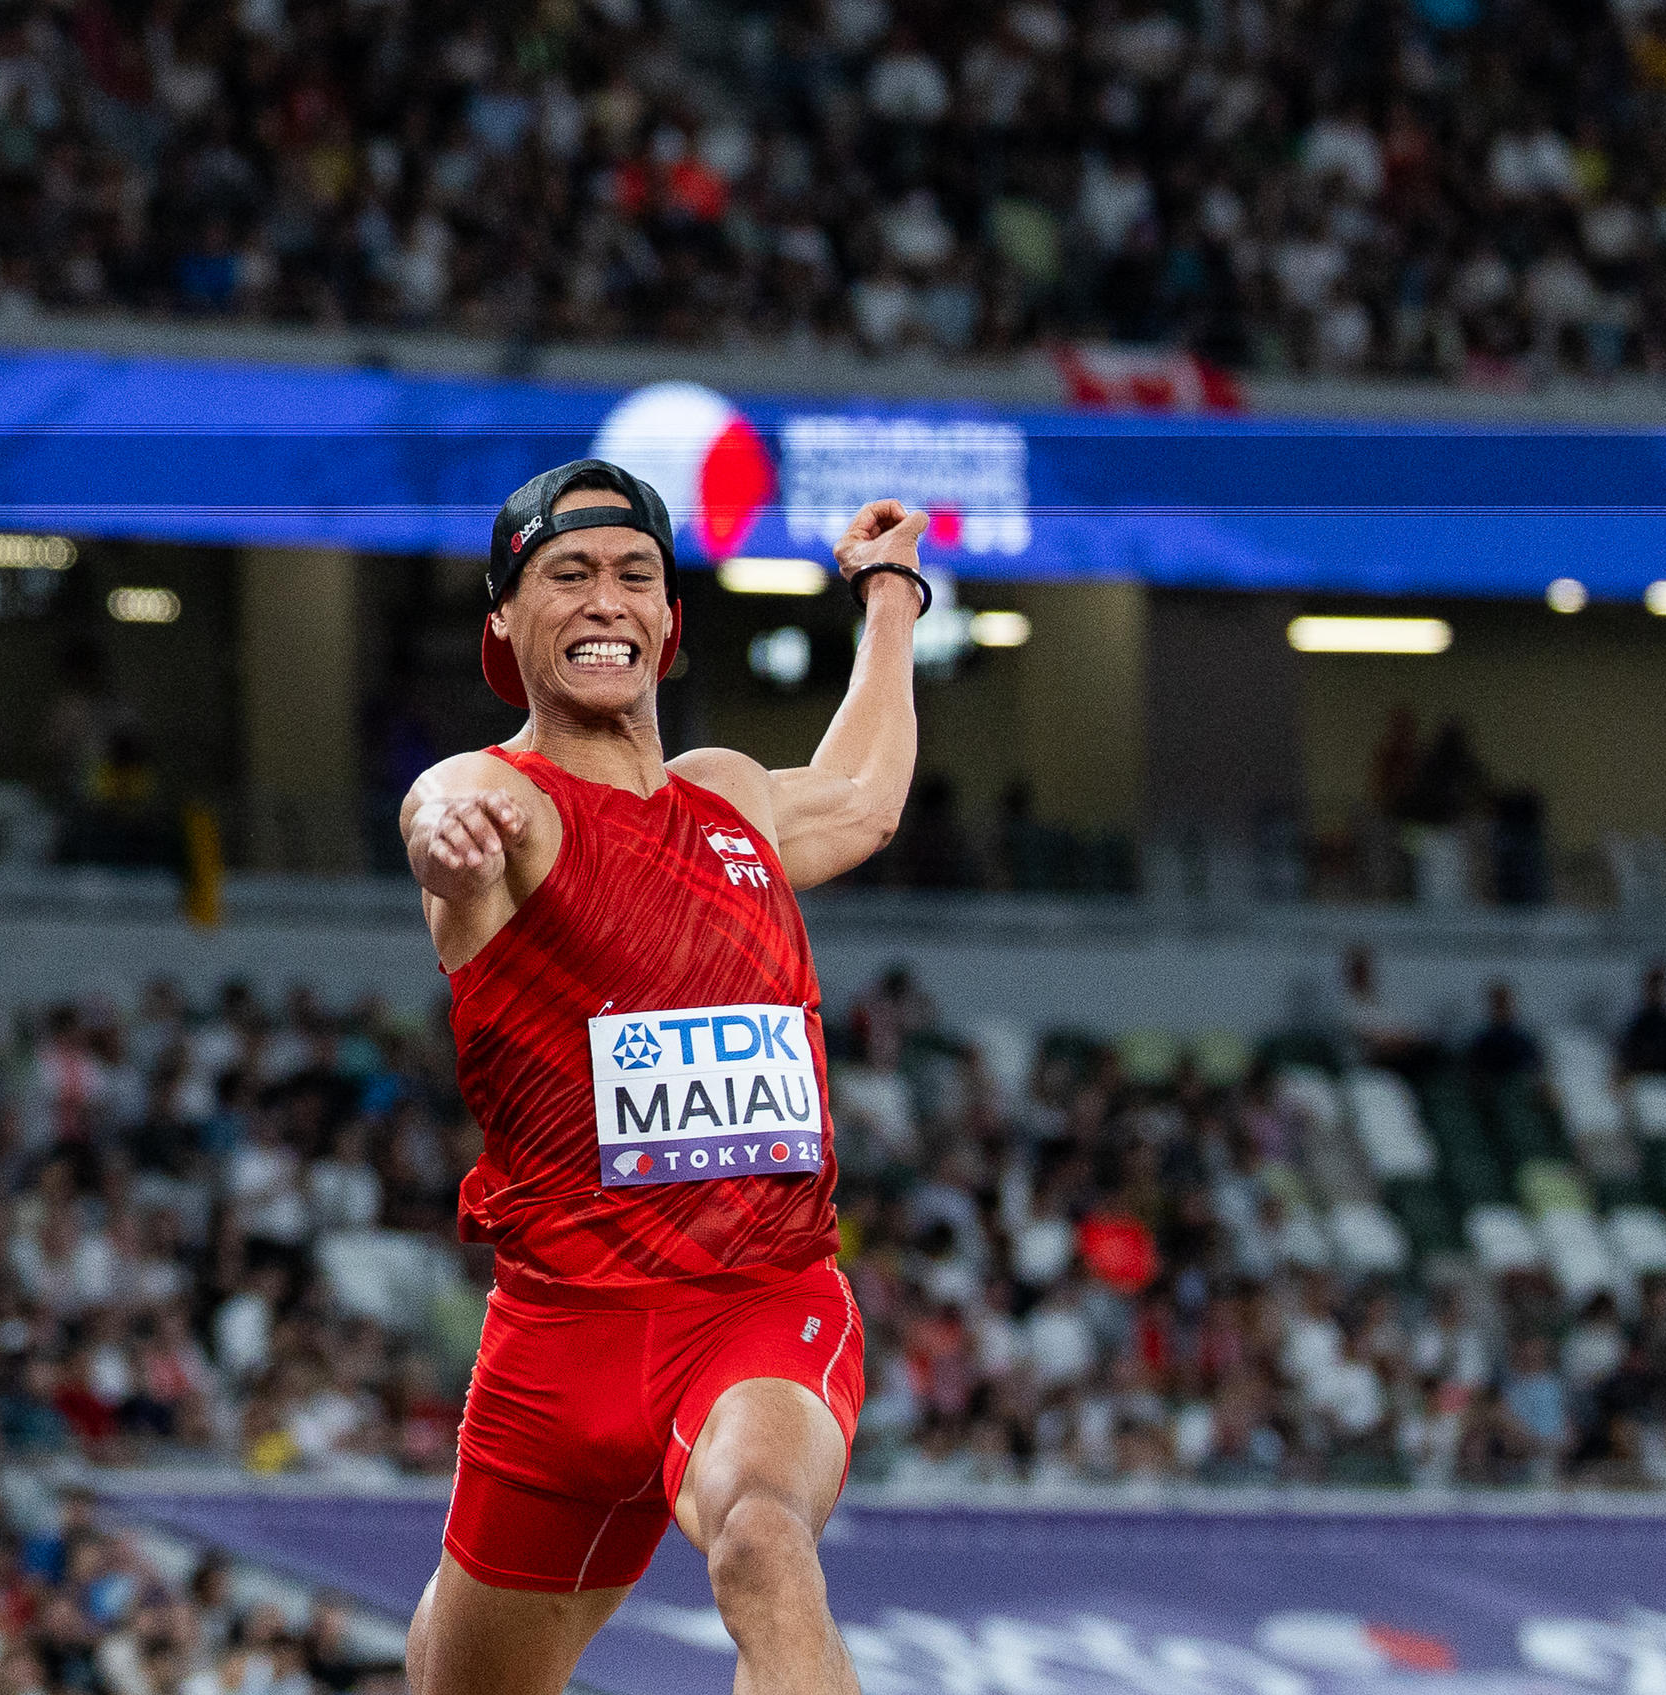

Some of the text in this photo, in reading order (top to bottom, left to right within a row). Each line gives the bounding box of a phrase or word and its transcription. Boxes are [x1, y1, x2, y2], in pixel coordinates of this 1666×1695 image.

[724, 862, 771, 889] PYF
[659, 1014, 799, 1065] TDK
[615, 1075, 811, 1135] MAIAU
